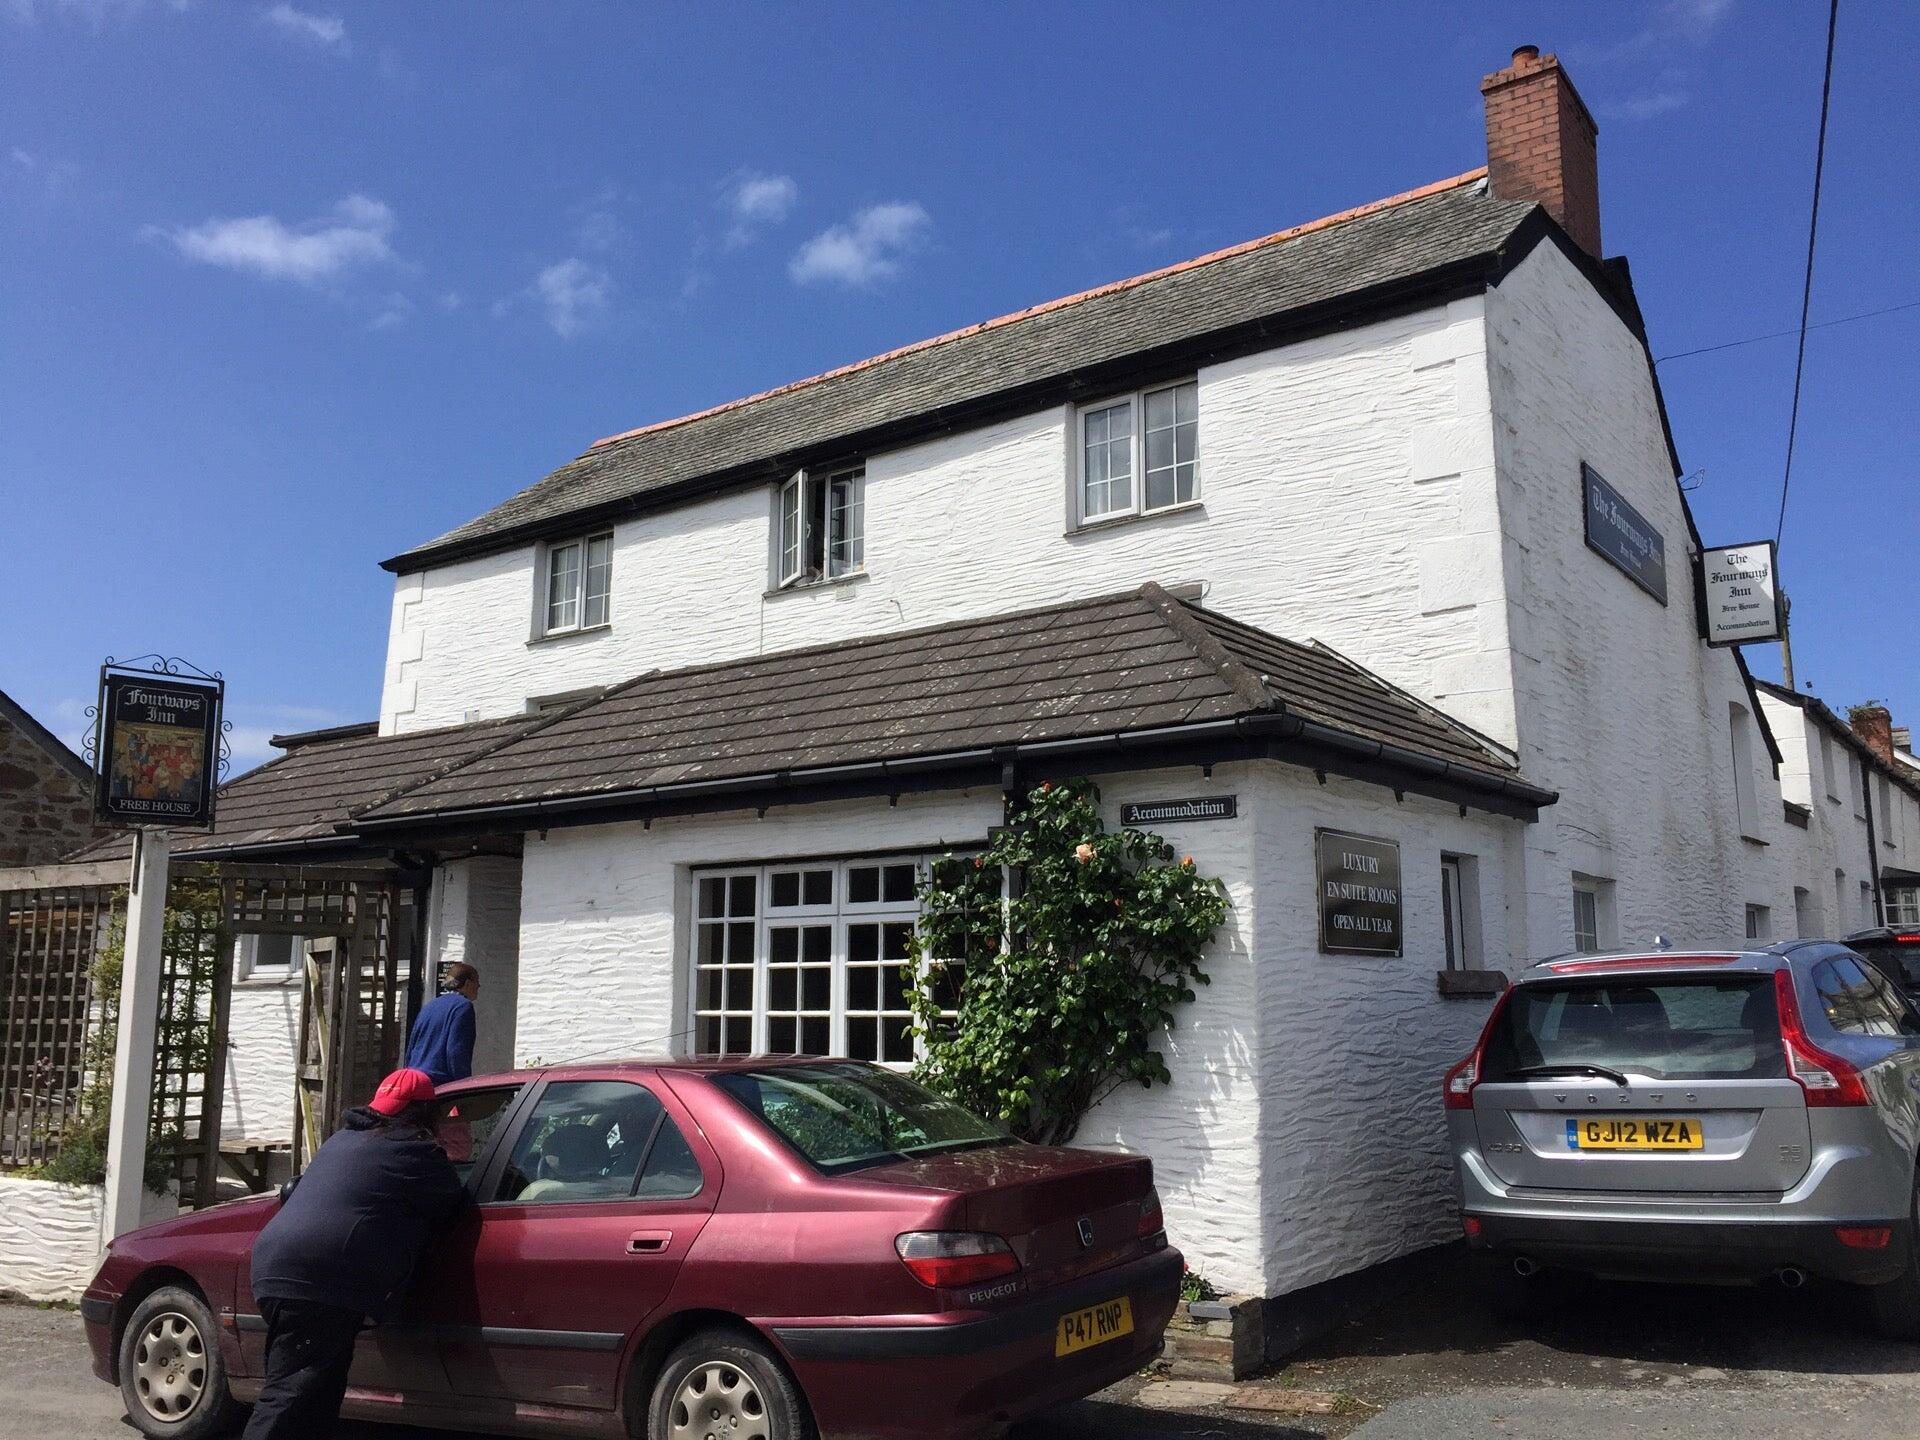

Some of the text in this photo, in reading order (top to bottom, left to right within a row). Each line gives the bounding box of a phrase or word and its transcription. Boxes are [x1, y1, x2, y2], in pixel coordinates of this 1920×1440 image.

[1592, 484, 1609, 520] The
[1727, 554, 1748, 566] The
[1710, 568, 1768, 584] Fourways
[1729, 586, 1751, 598] Inn
[1721, 605, 1737, 613] Free
[1716, 620, 1770, 631] Accommodation
[125, 689, 200, 712] Fourways
[146, 706, 176, 723] Inn
[120, 800, 191, 813] FREE HOUSE
[1130, 801, 1225, 821] Accommodation
[1343, 852, 1379, 874] LUXURY
[1327, 881, 1397, 904] EN SUITE ROOMS
[1333, 914, 1392, 933] OPEN ALL YEAR
[1586, 1121, 1692, 1143] GJ12 WZA
[969, 1281, 1017, 1303] PEUGEOT
[1064, 1303, 1122, 1346] P47 RNP
